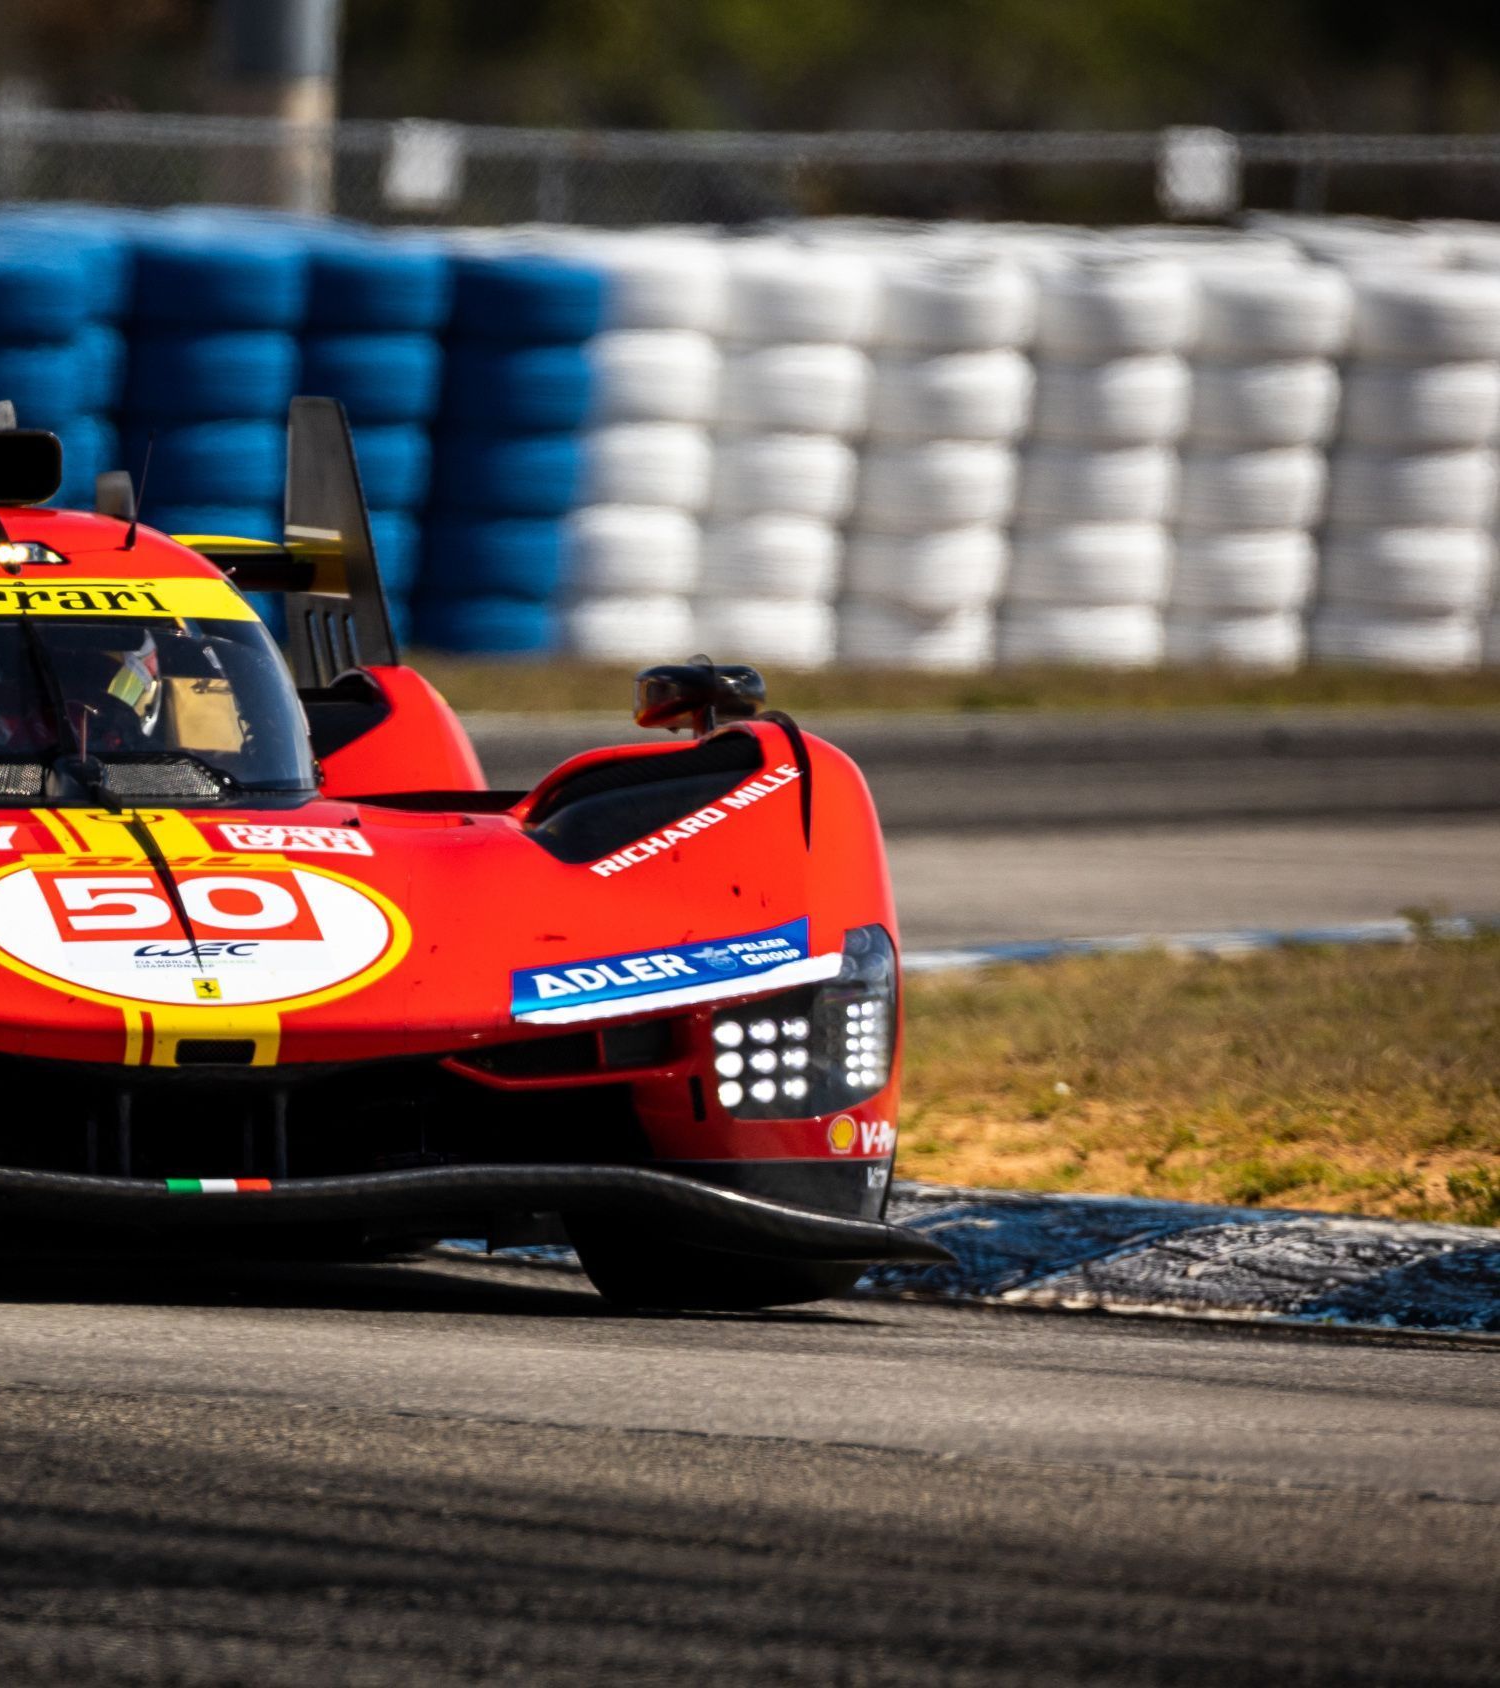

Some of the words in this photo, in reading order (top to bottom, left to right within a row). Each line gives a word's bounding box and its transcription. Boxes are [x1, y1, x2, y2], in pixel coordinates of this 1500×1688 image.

[236, 834, 362, 851] CAR
[589, 807, 728, 877] RICHARD
[720, 764, 803, 810] MILLE
[53, 876, 299, 931] 50
[133, 942, 260, 957] WEC
[531, 954, 698, 999] ADLER
